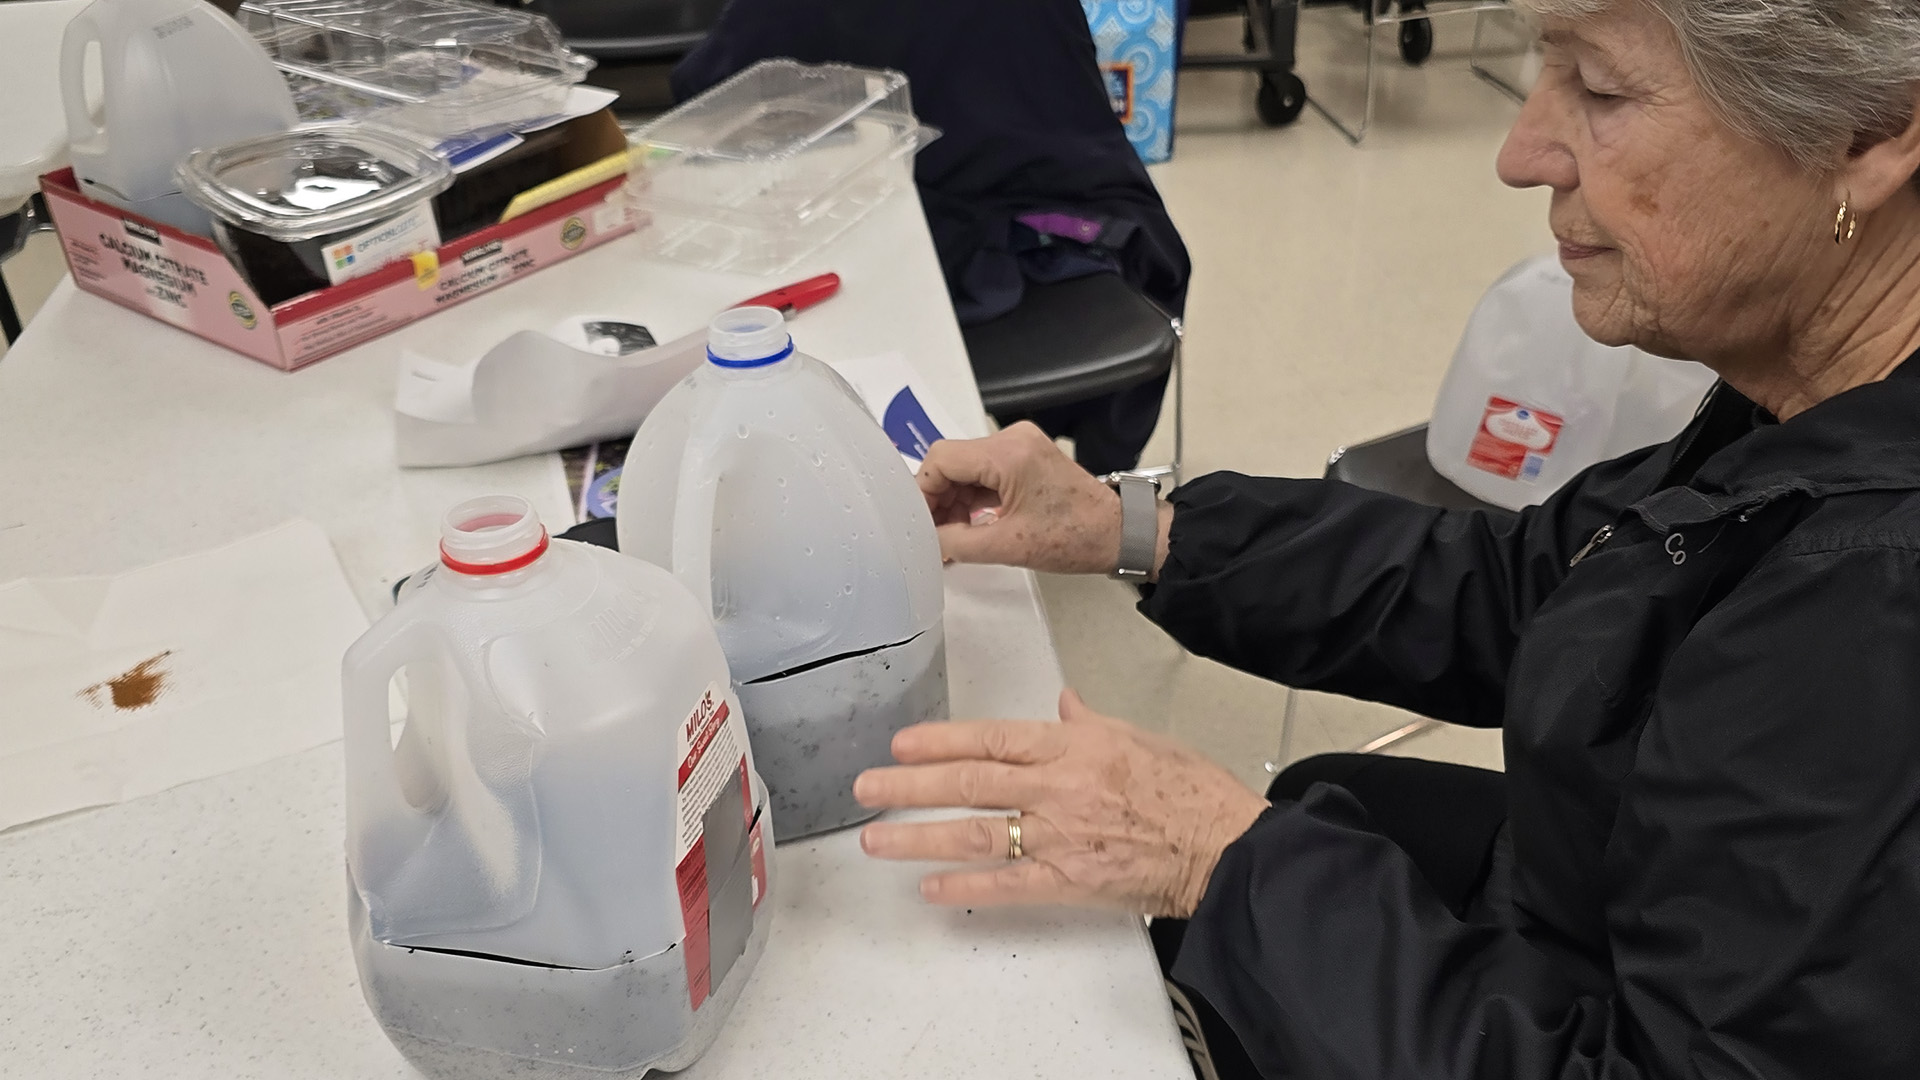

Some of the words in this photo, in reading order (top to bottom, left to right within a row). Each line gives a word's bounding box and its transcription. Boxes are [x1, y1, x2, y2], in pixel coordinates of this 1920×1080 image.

[99, 233, 151, 261] CALCIUM
[155, 254, 209, 286] CITRATE
[121, 257, 198, 297] MAGNESIUM
